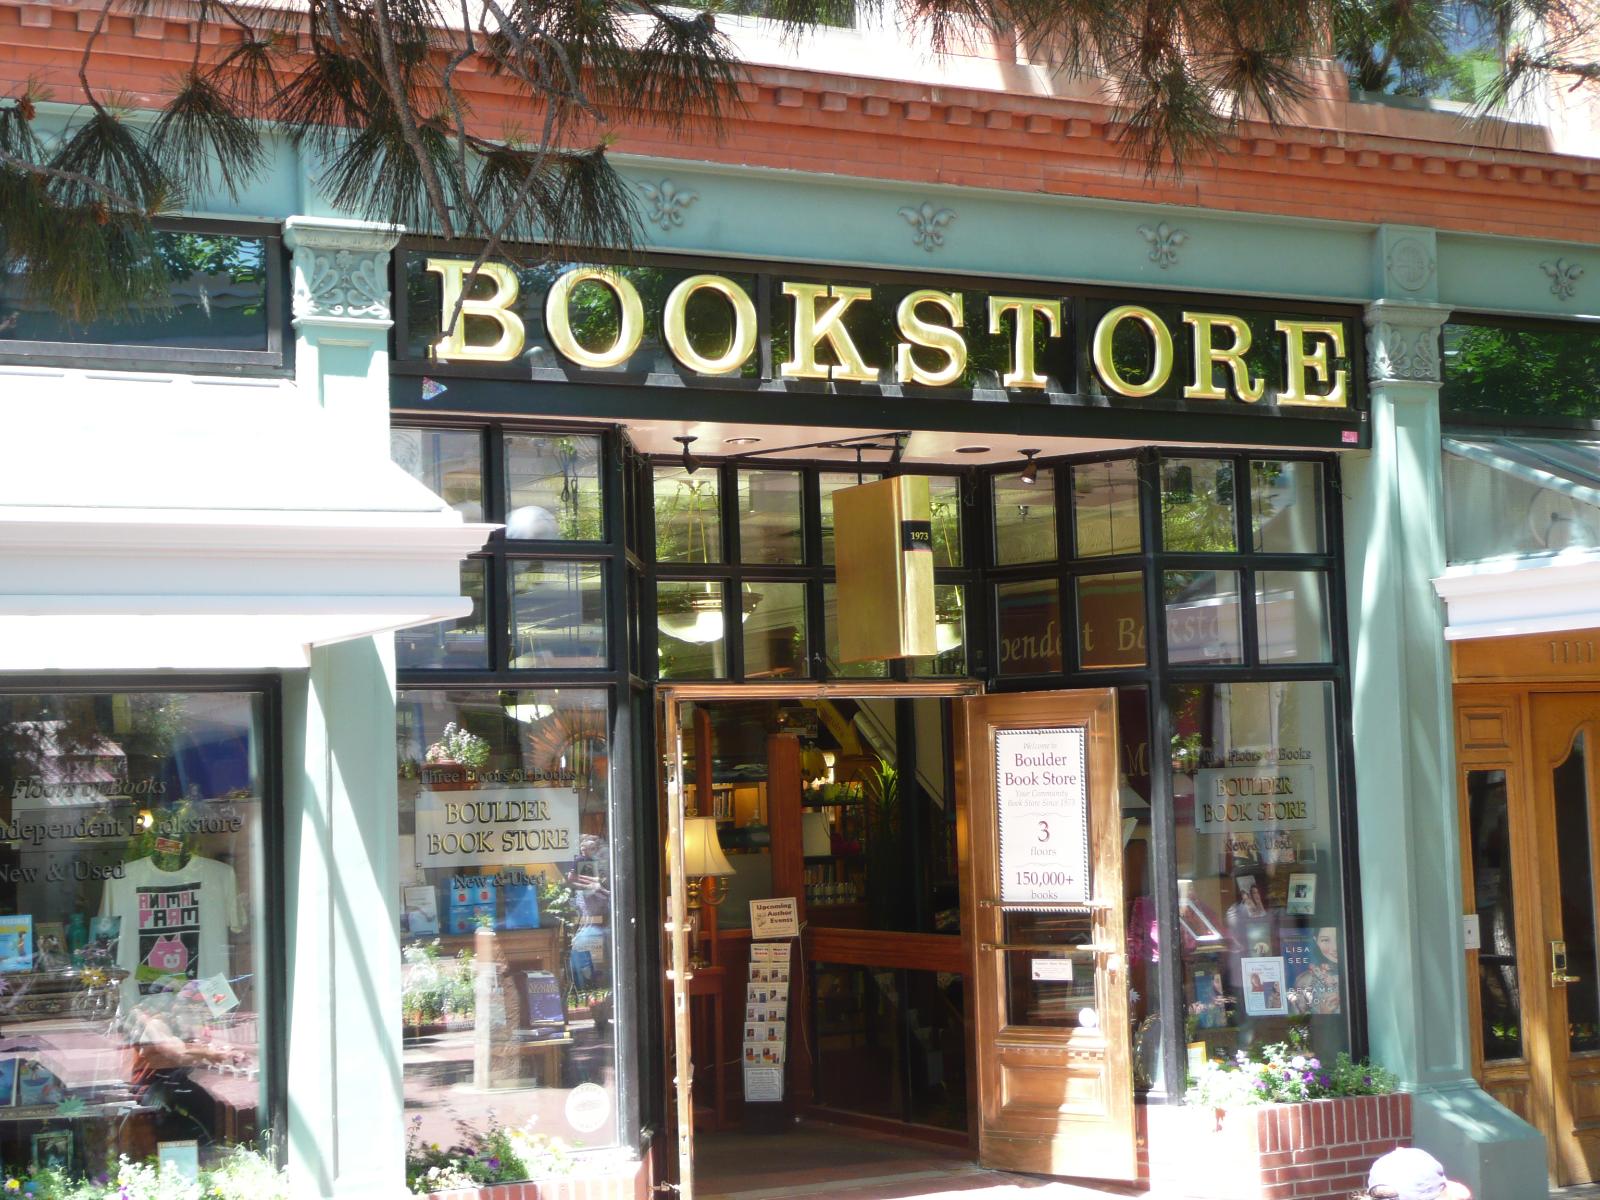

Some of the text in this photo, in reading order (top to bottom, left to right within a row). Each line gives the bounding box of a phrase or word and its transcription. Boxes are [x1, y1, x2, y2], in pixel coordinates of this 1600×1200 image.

[426, 257, 1347, 408] BOOKSTORE
[910, 530, 929, 541] 1973
[1014, 752, 1068, 767] Boulder
[106, 775, 168, 796] Books
[419, 770, 459, 785] Three
[532, 767, 577, 782] Books
[1005, 771, 1077, 786] Book Store
[1215, 776, 1293, 797] BOULDER
[445, 800, 551, 825] BOULDER
[1202, 800, 1308, 823] BOOK STORE
[1037, 820, 1051, 843] 3
[427, 829, 570, 855] BOOK STORE
[1030, 846, 1057, 856] floors
[46, 862, 64, 882] &
[73, 859, 126, 882] Used
[453, 873, 487, 890] New
[510, 870, 546, 887] Used
[1015, 871, 1075, 887] 150,000+
[139, 891, 200, 909] ANIMAL
[1031, 890, 1058, 900] books
[756, 903, 792, 911] Upcoming
[139, 908, 200, 929] FARM
